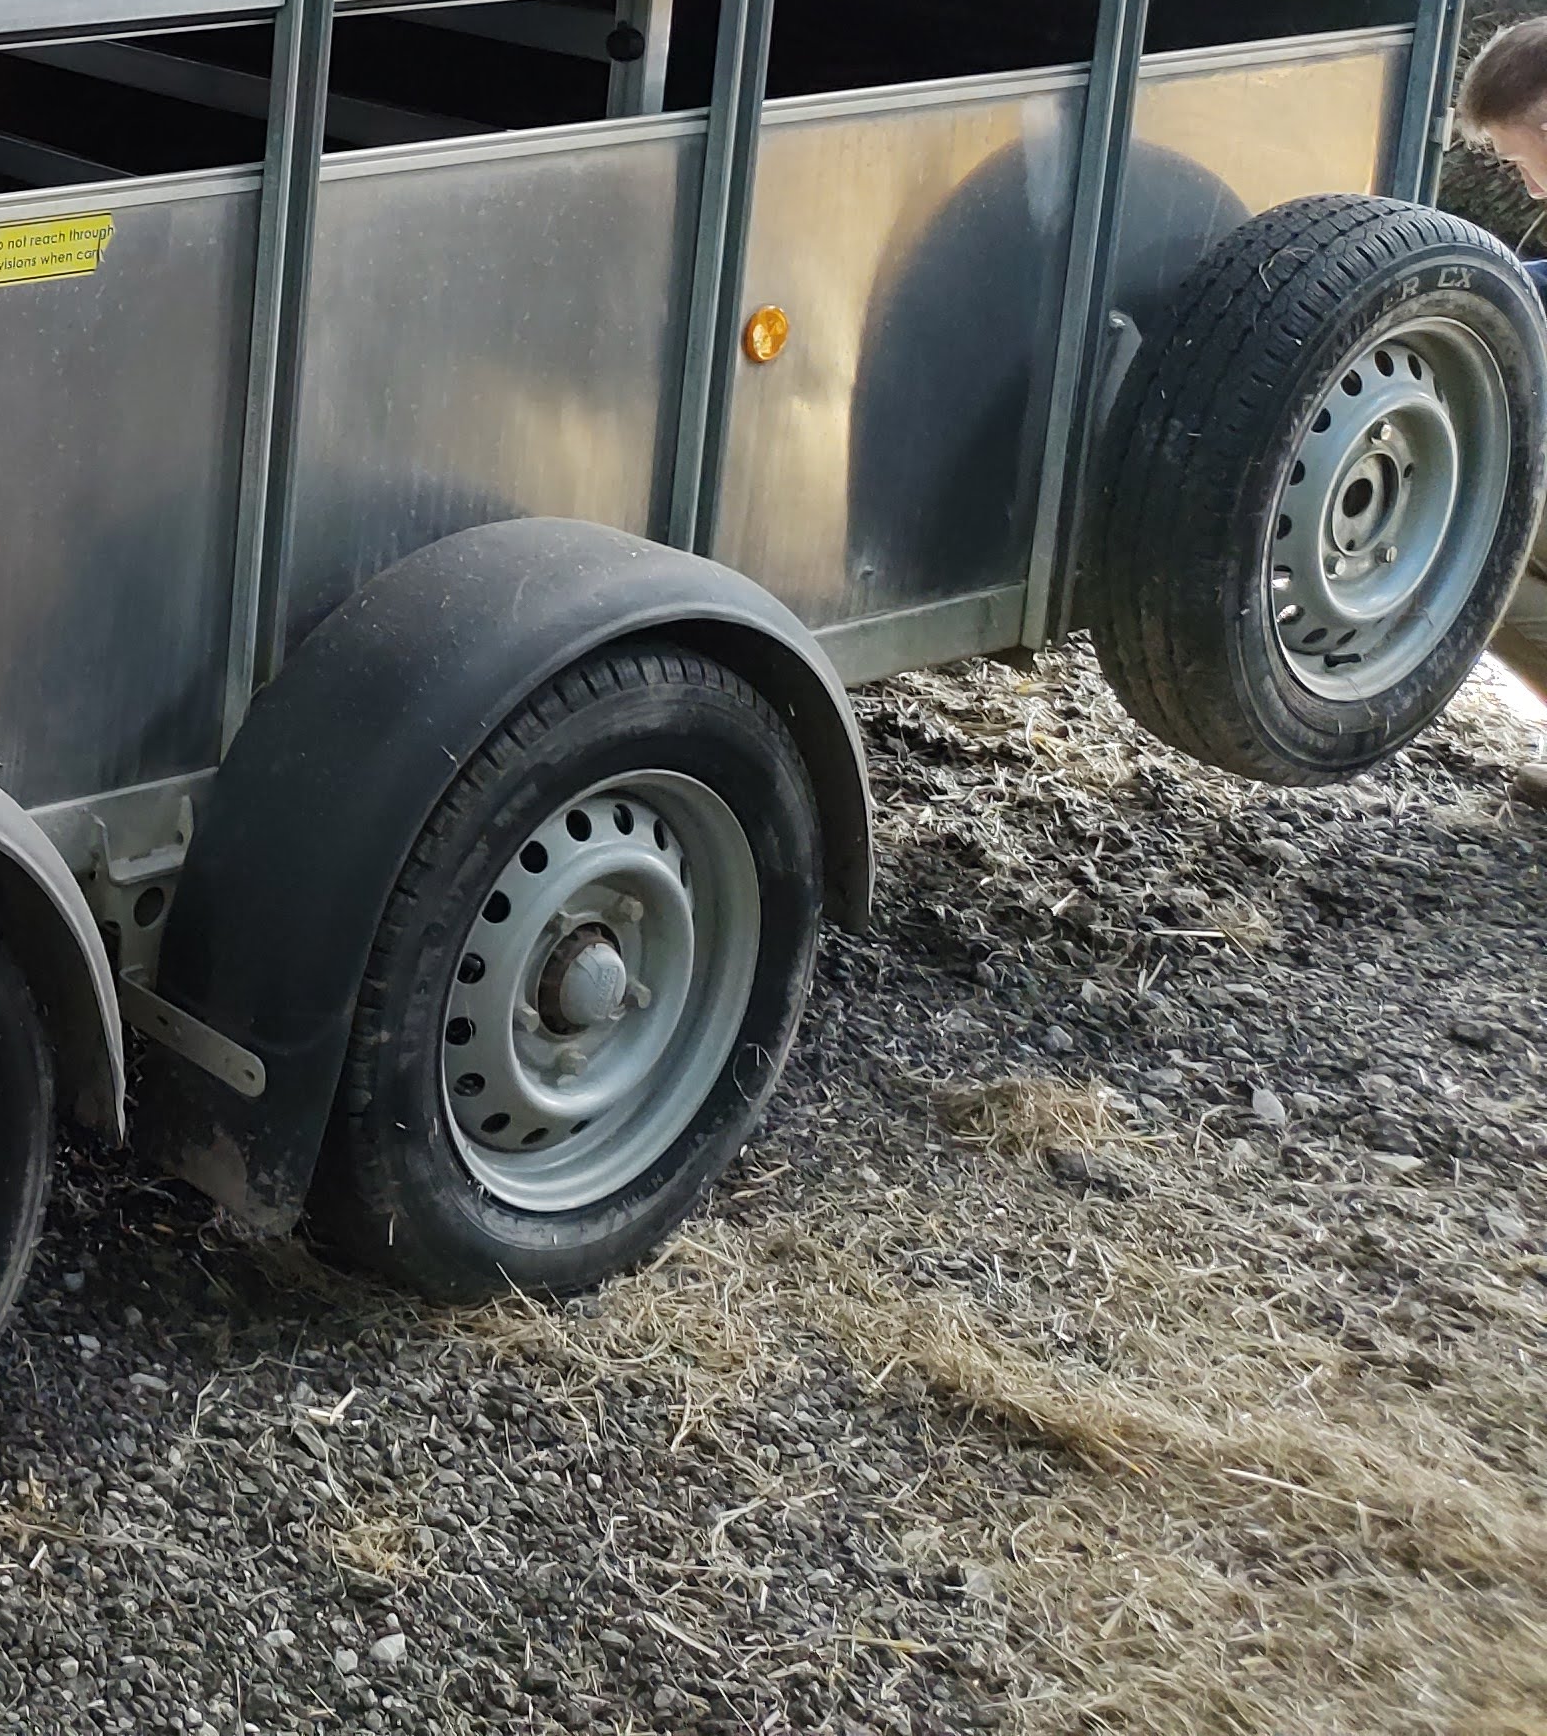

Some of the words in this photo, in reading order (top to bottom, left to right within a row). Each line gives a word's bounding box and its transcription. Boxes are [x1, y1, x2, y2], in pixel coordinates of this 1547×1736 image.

[7, 235, 27, 250] not
[30, 232, 66, 247] reach
[69, 224, 114, 241] through
[40, 251, 73, 265] when
